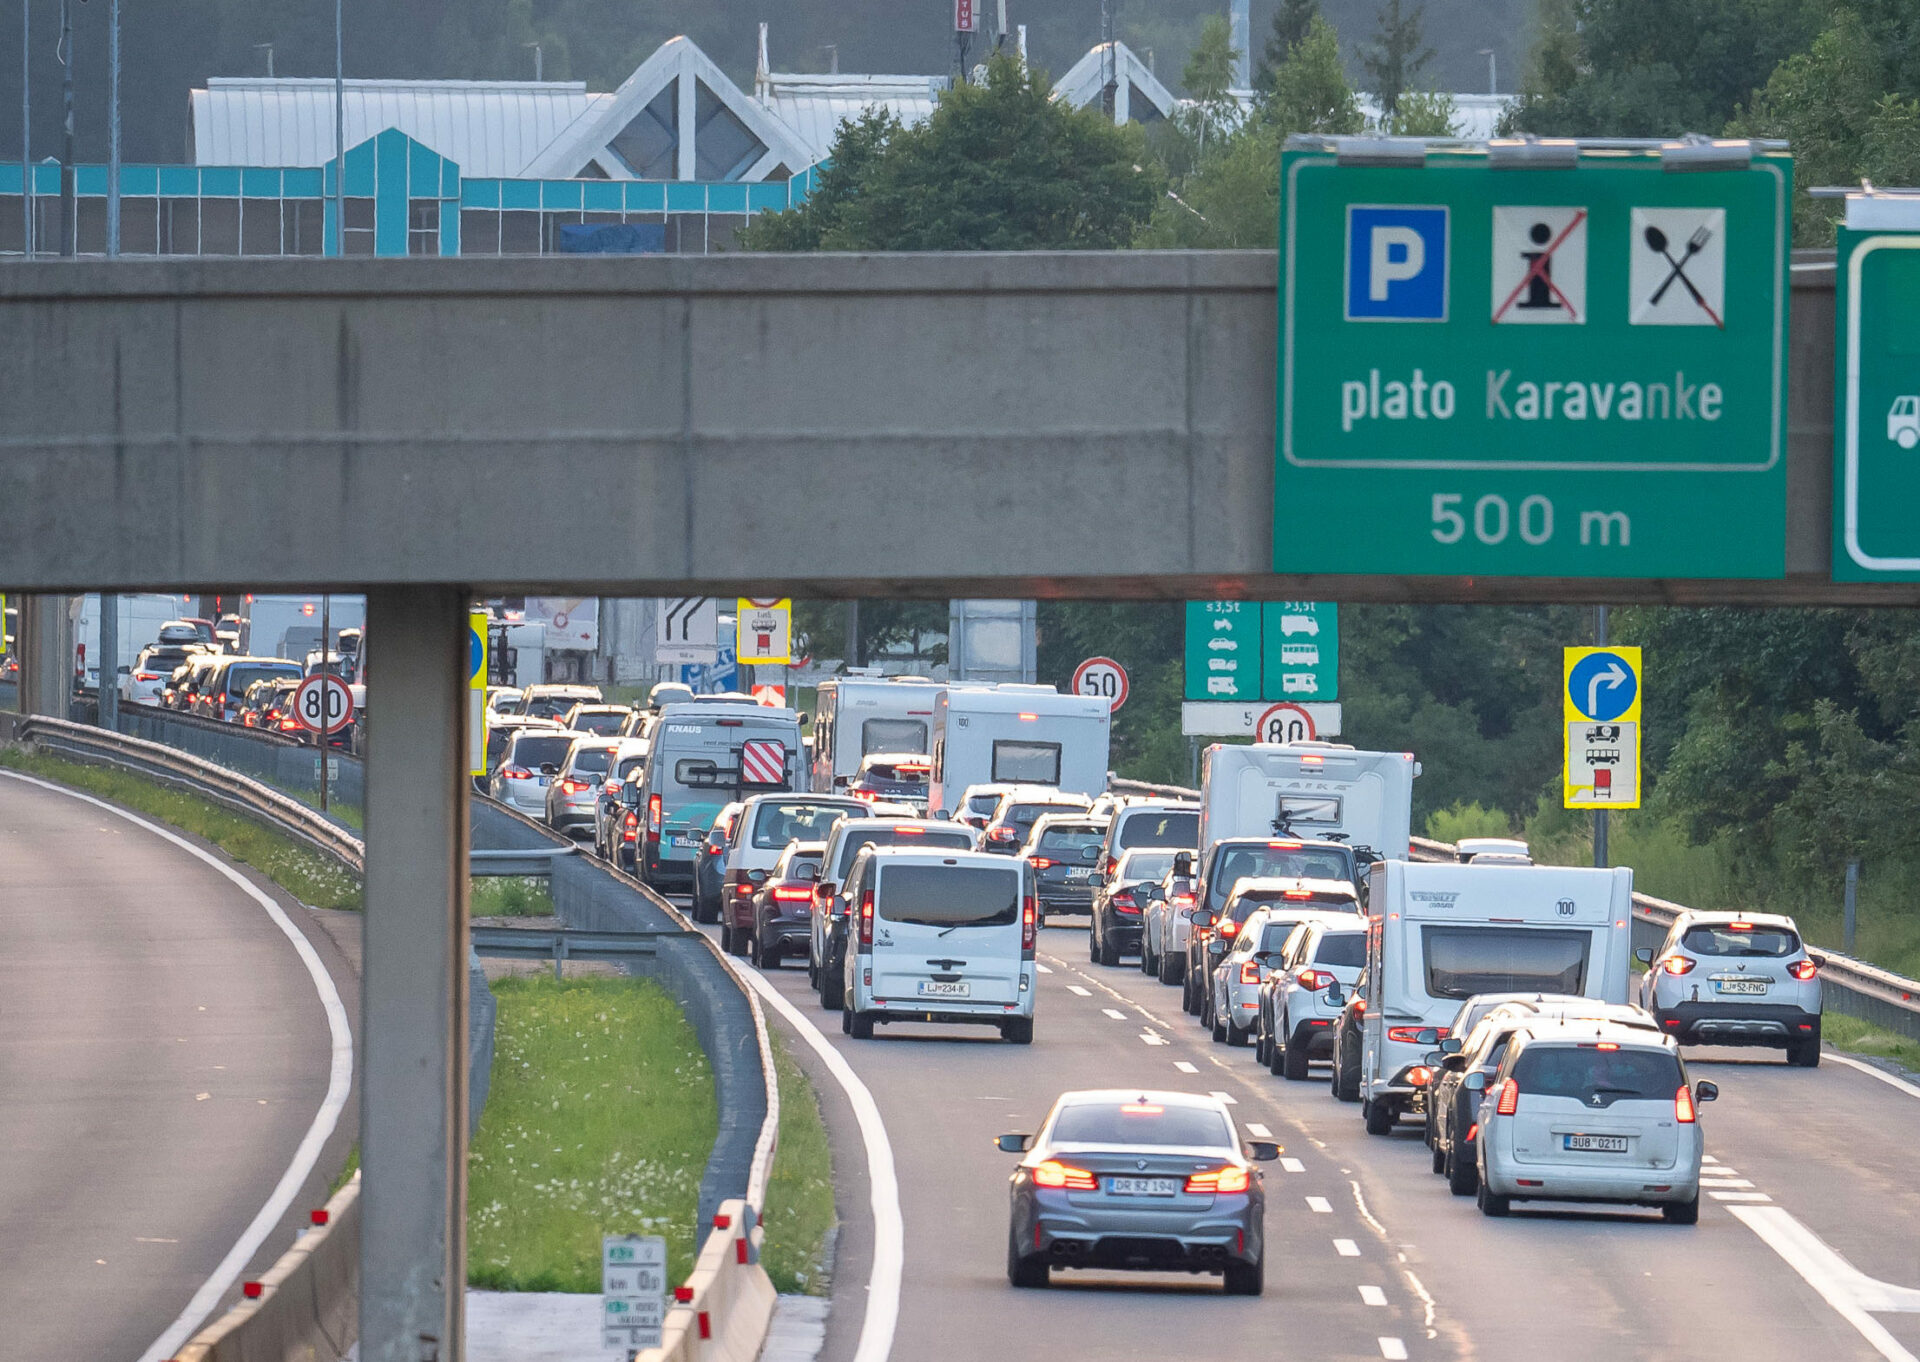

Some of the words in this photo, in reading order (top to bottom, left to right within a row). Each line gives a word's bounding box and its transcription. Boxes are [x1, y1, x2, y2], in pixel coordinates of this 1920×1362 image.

[1369, 225, 1425, 301] P
[1342, 369, 1455, 433] plato
[1486, 370, 1723, 421] Karavanke
[1431, 494, 1554, 546] 500
[1580, 510, 1631, 546] m
[1084, 672, 1116, 697] 50
[306, 689, 341, 718] 80
[667, 725, 702, 733] KNAUS
[1268, 718, 1303, 743] 80
[1557, 901, 1575, 915] 100
[1598, 1138, 1622, 1149] 0211
